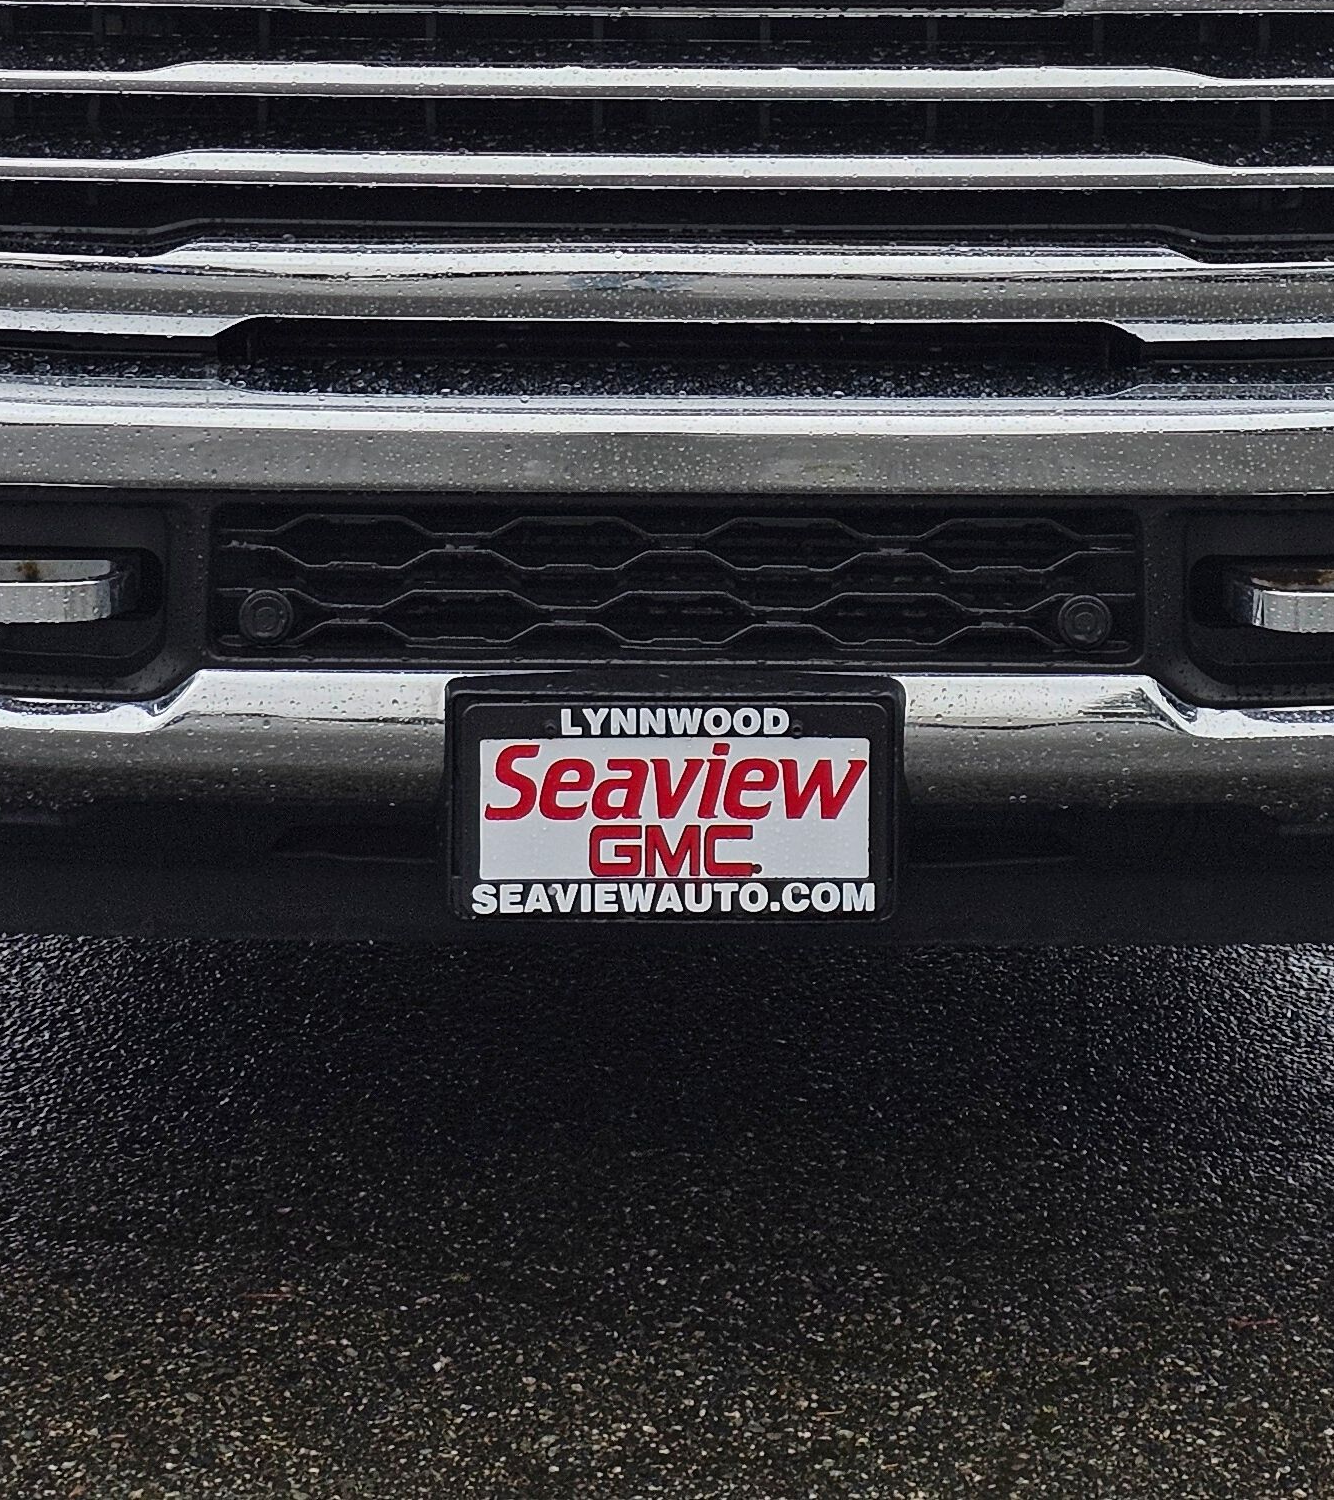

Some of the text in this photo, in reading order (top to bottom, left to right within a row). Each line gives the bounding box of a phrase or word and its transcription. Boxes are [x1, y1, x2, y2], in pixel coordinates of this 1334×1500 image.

[560, 707, 790, 736] LYNNWOOD
[484, 742, 868, 821] Seaview
[588, 824, 754, 878] GMC
[471, 882, 876, 915] SEAVIEWAUTO.COM
